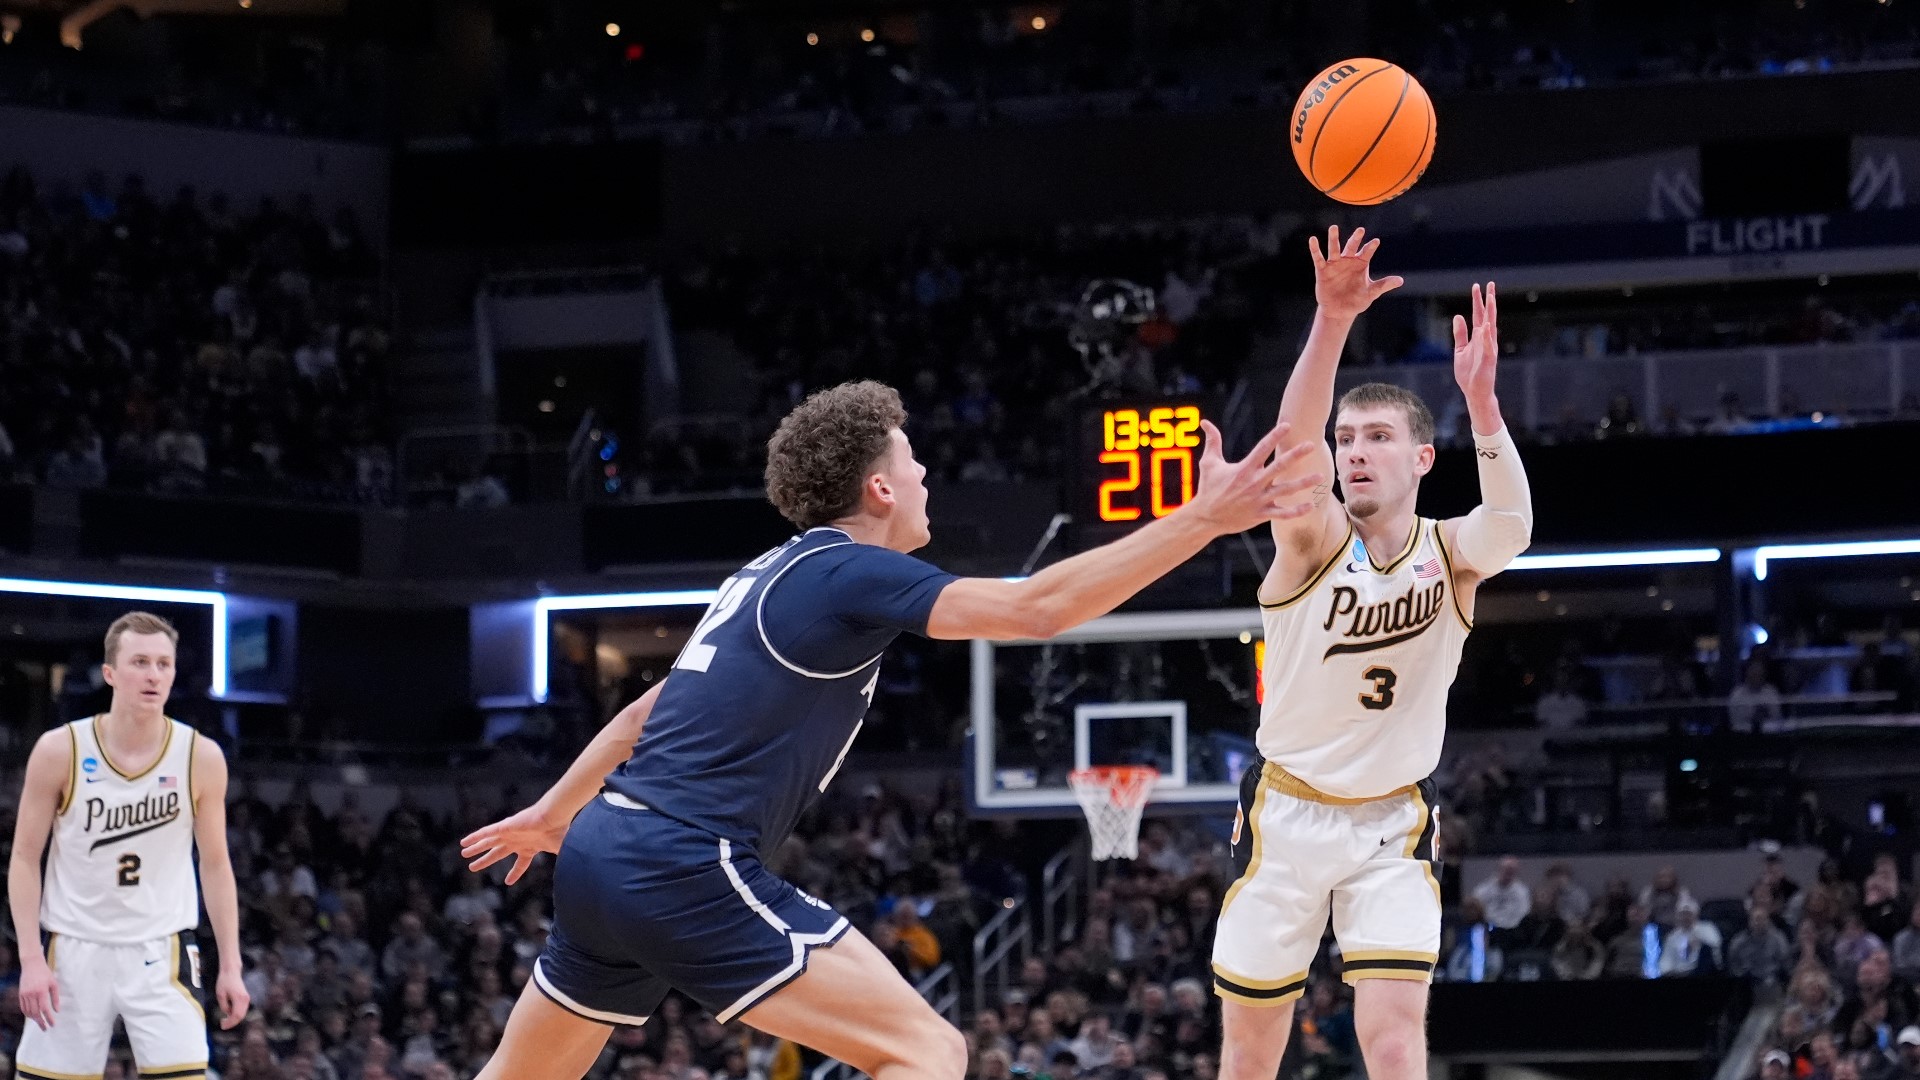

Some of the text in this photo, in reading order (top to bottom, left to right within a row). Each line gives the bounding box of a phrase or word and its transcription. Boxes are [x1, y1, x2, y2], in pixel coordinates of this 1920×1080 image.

[1294, 63, 1360, 144] Wilson
[1687, 215, 1829, 254] FLIGHT
[1104, 406, 1200, 451] 13:52
[1099, 448, 1193, 521] 20
[1323, 580, 1445, 638] Purdue
[1357, 665, 1398, 711] 3
[83, 791, 179, 833] Purdue
[117, 852, 141, 887] 2
